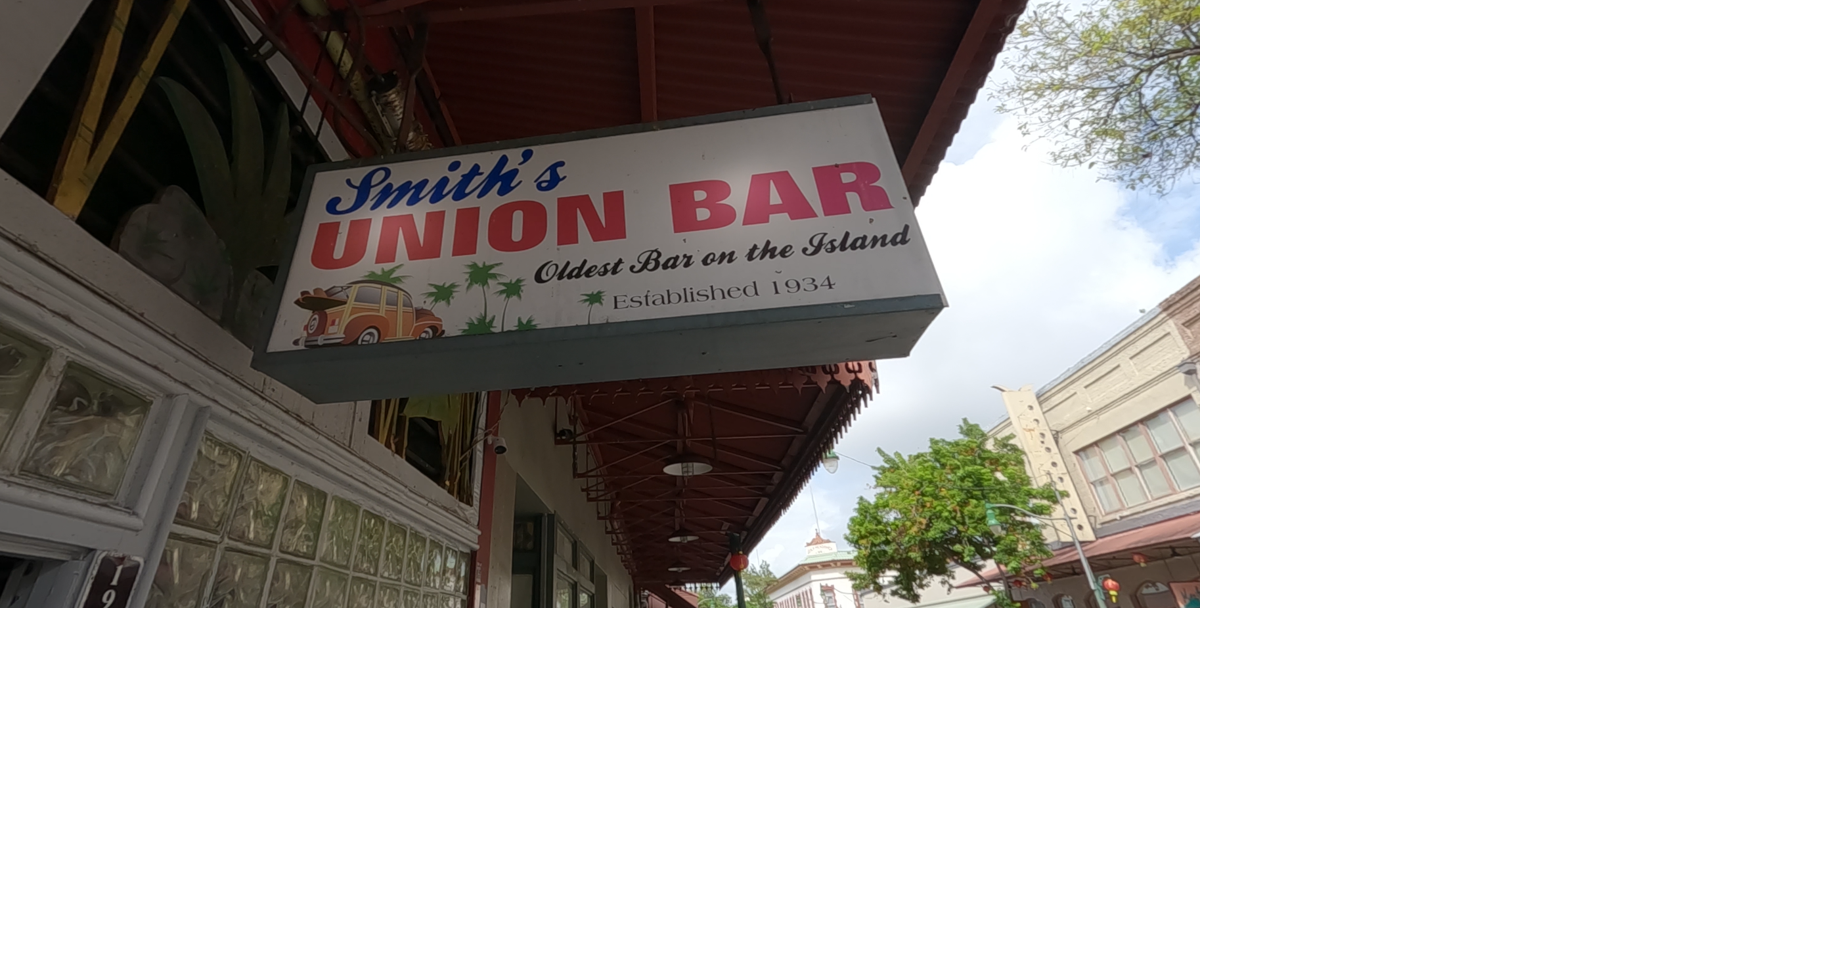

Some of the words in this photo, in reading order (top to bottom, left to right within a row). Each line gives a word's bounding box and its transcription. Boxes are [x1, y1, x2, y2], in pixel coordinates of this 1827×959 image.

[325, 148, 566, 215] Smith's
[310, 190, 627, 270] UNION
[668, 161, 894, 234] BAR
[534, 257, 624, 284] Oldest
[629, 246, 694, 275] Bar
[700, 249, 738, 267] on
[744, 239, 796, 263] the
[801, 224, 911, 257] Island
[612, 281, 760, 310] Established
[771, 275, 837, 296] 1934
